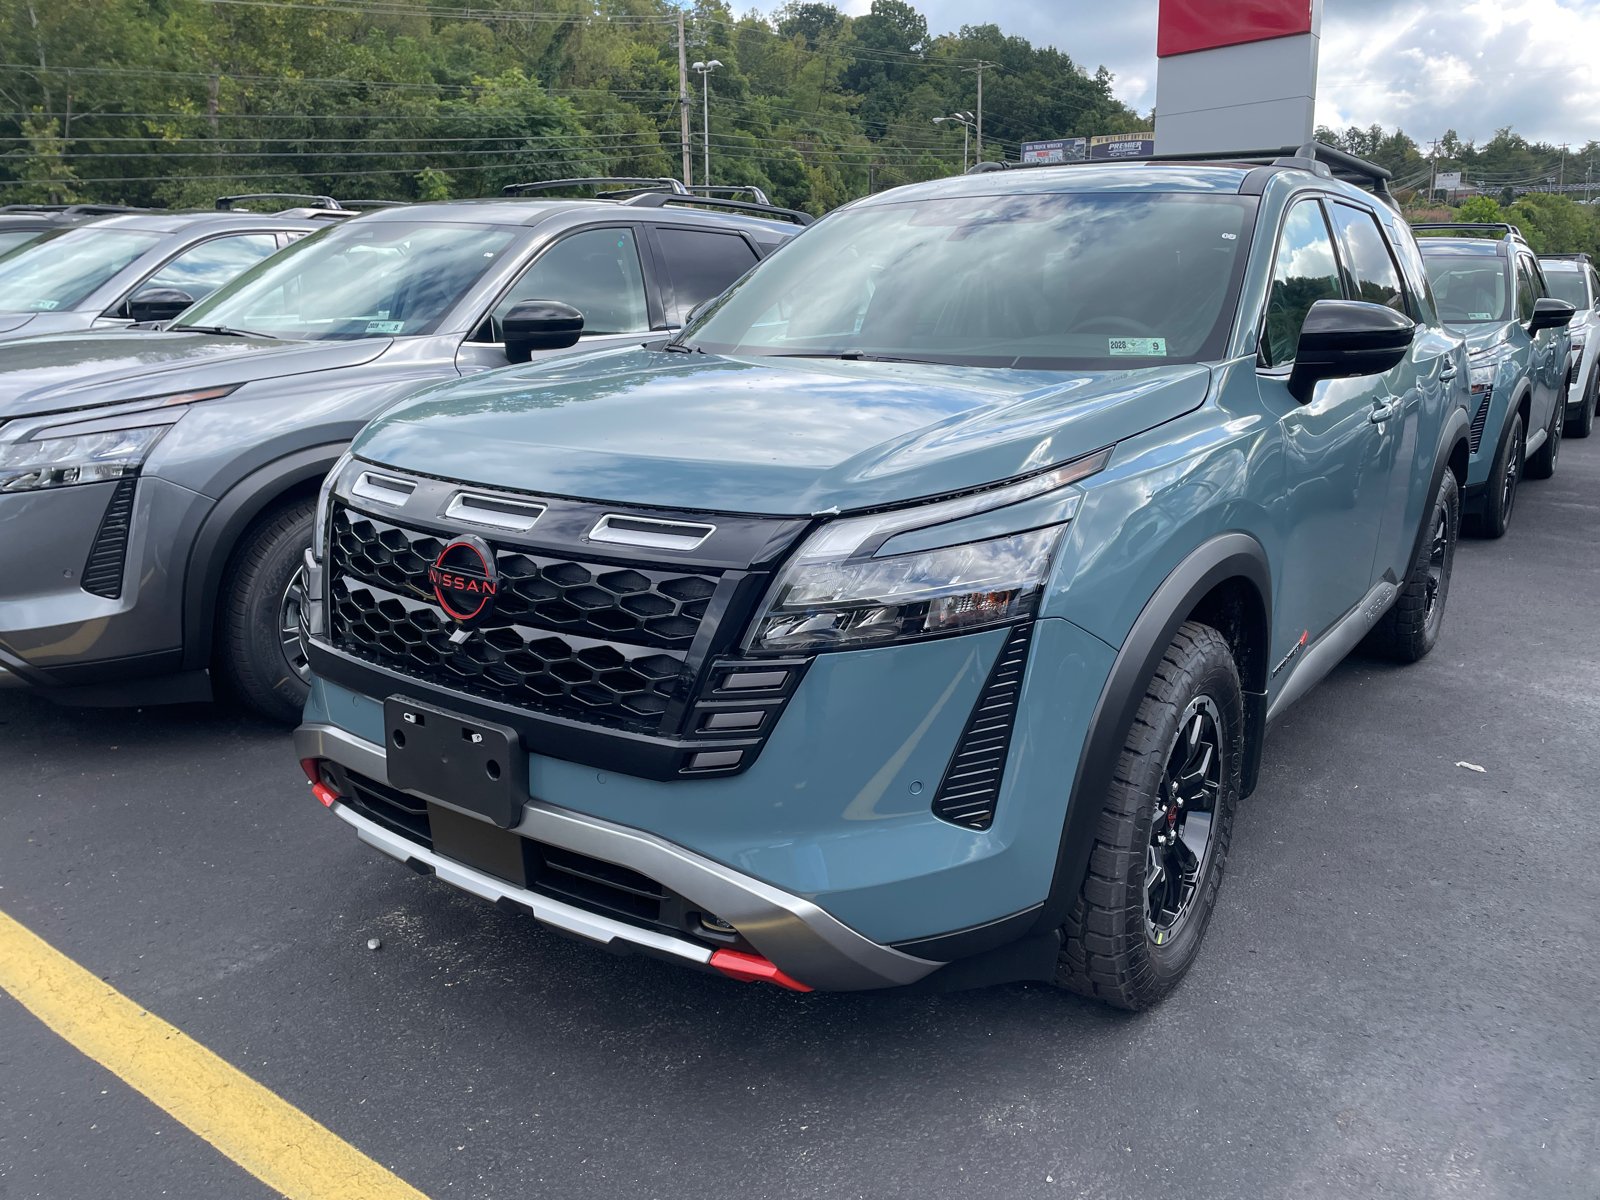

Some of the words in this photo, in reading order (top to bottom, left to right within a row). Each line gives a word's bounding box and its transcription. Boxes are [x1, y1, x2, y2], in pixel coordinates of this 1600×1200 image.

[1108, 141, 1142, 150] PREMIER
[1110, 341, 1127, 349] 2028
[1152, 342, 1159, 350] 9
[429, 569, 496, 595] NISSAN
